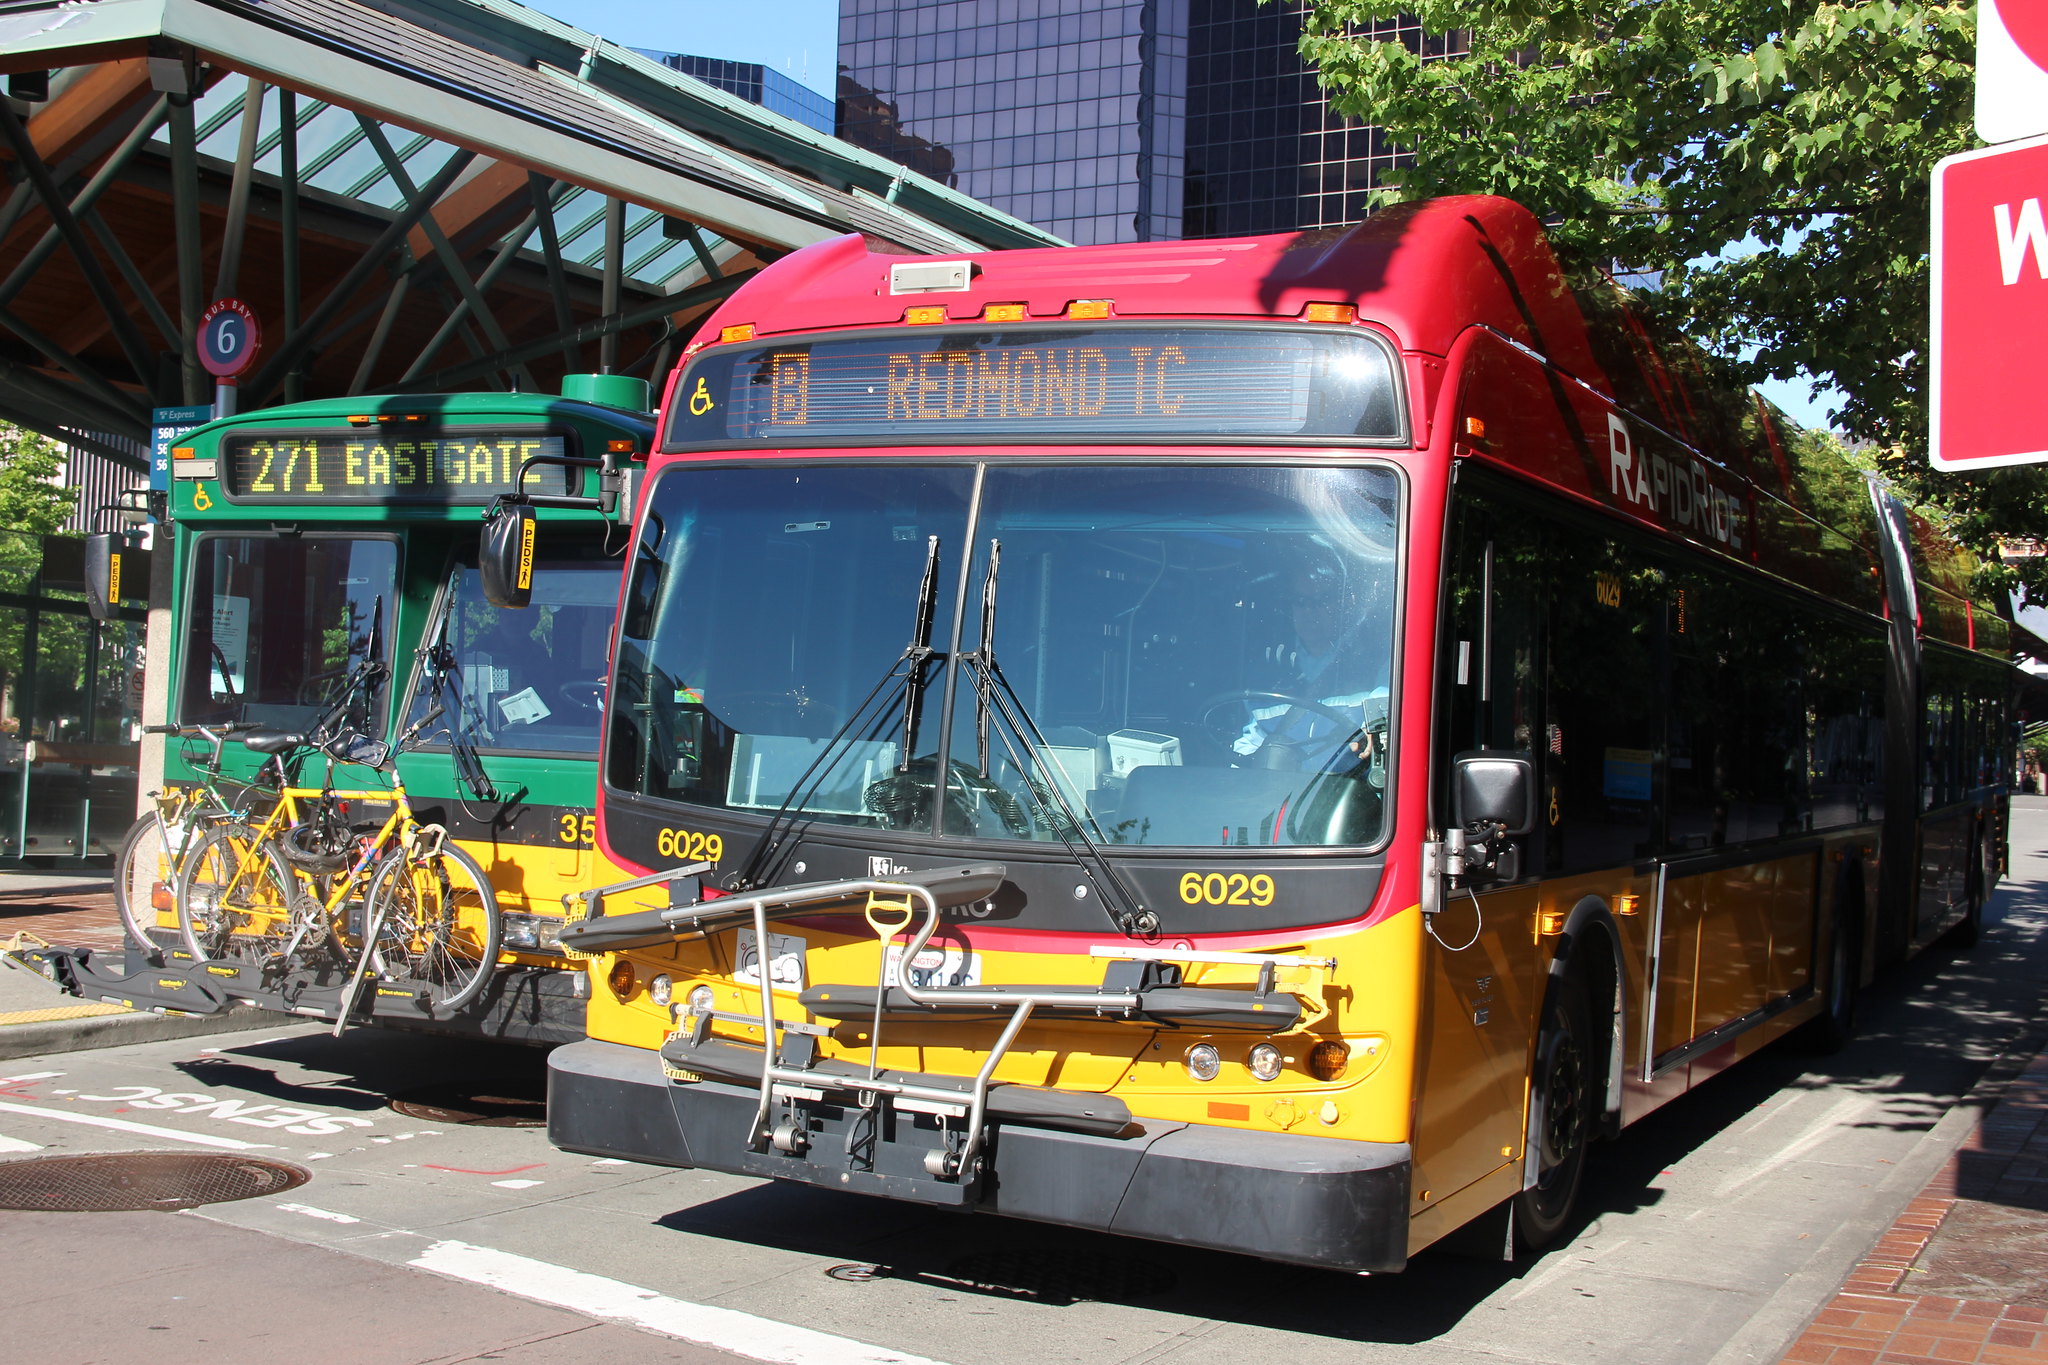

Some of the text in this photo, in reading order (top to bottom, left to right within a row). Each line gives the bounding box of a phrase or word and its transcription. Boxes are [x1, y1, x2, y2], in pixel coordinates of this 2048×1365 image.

[204, 300, 251, 321] BUS BAY
[217, 319, 235, 354] 6
[886, 349, 1107, 419] REDMOND
[1130, 346, 1188, 415] TC
[168, 410, 195, 420] Express
[158, 427, 174, 439] 560
[250, 440, 541, 492] 271 EASTGATE
[523, 529, 533, 567] PEDS
[1596, 574, 1622, 609] 6029
[657, 827, 723, 863] 6029
[1179, 871, 1276, 907] 6029
